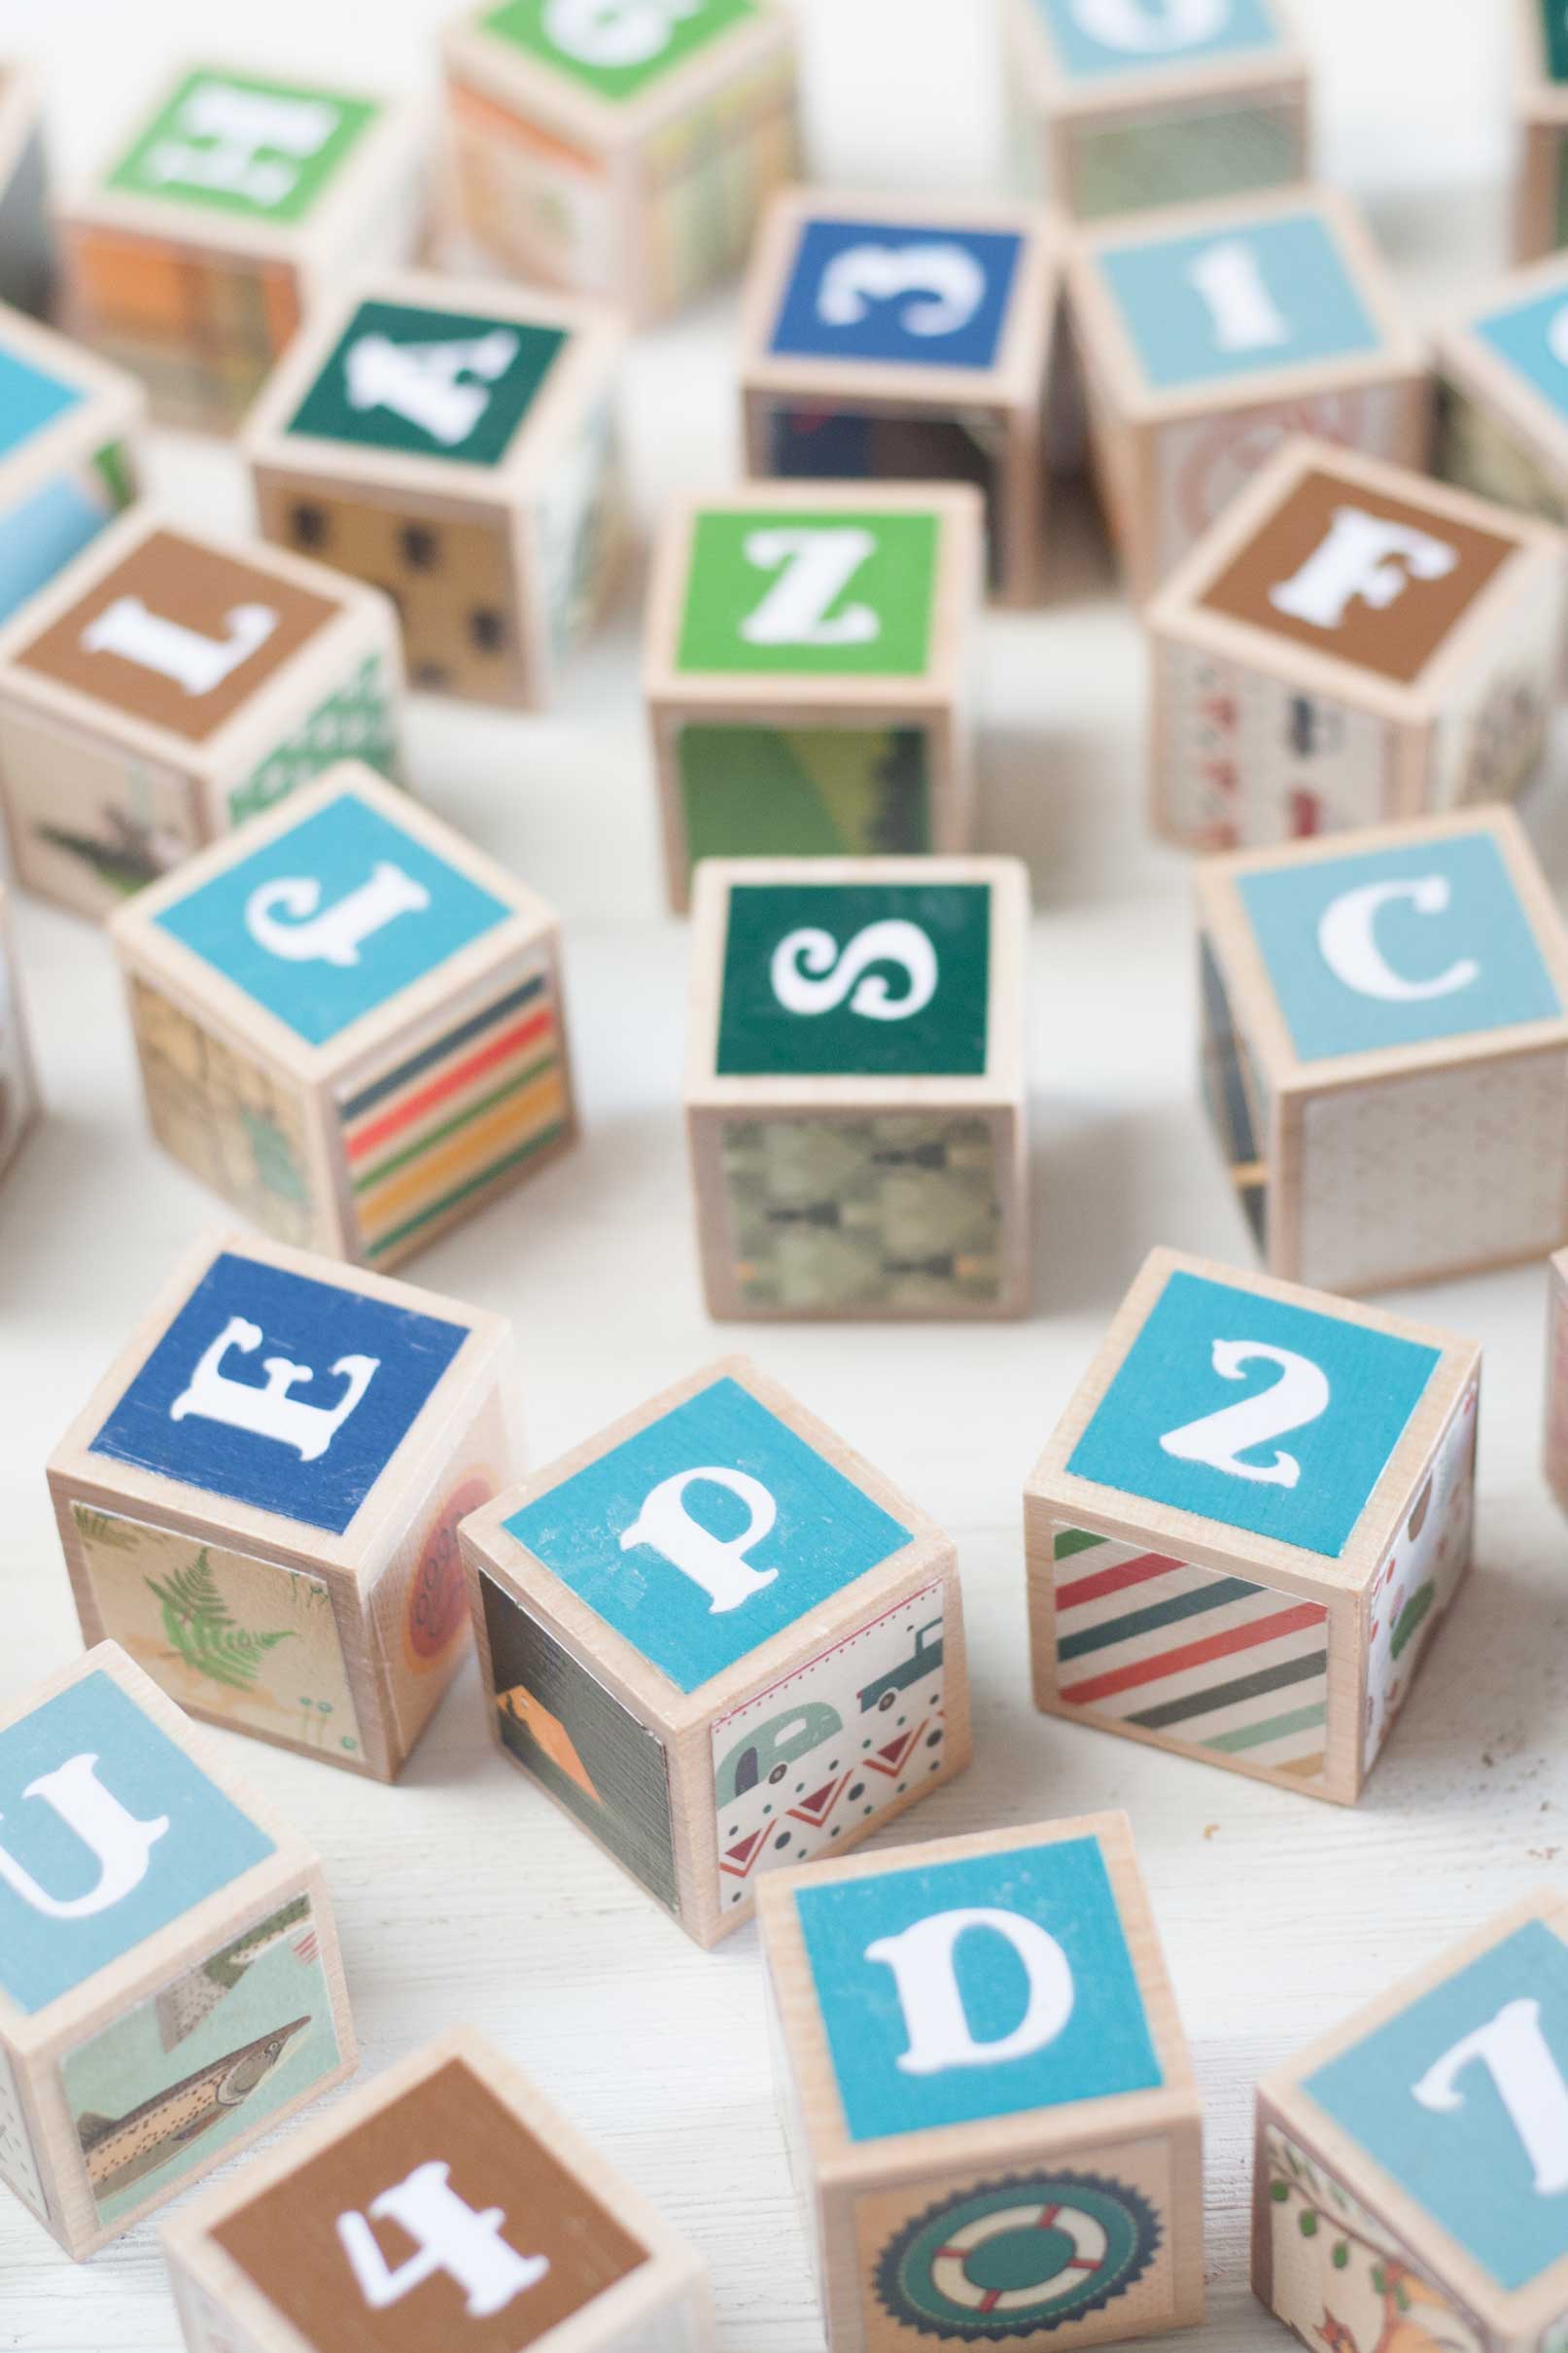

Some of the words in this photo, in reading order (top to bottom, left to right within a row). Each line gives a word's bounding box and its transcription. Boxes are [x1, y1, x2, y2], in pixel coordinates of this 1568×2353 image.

[143, 84, 338, 205] H
[818, 244, 985, 336] 3
[345, 333, 518, 444] A
[740, 527, 881, 646] Z
[1269, 507, 1457, 629] F
[81, 597, 278, 695] L
[245, 861, 431, 966] J
[771, 920, 938, 1021] S
[1318, 874, 1480, 1001] C
[170, 1317, 380, 1461] E
[1159, 1338, 1330, 1489] 2
[618, 1465, 779, 1614] P
[0, 1753, 170, 1919] U
[864, 1907, 1075, 2075] D
[335, 2160, 549, 2317] 4
